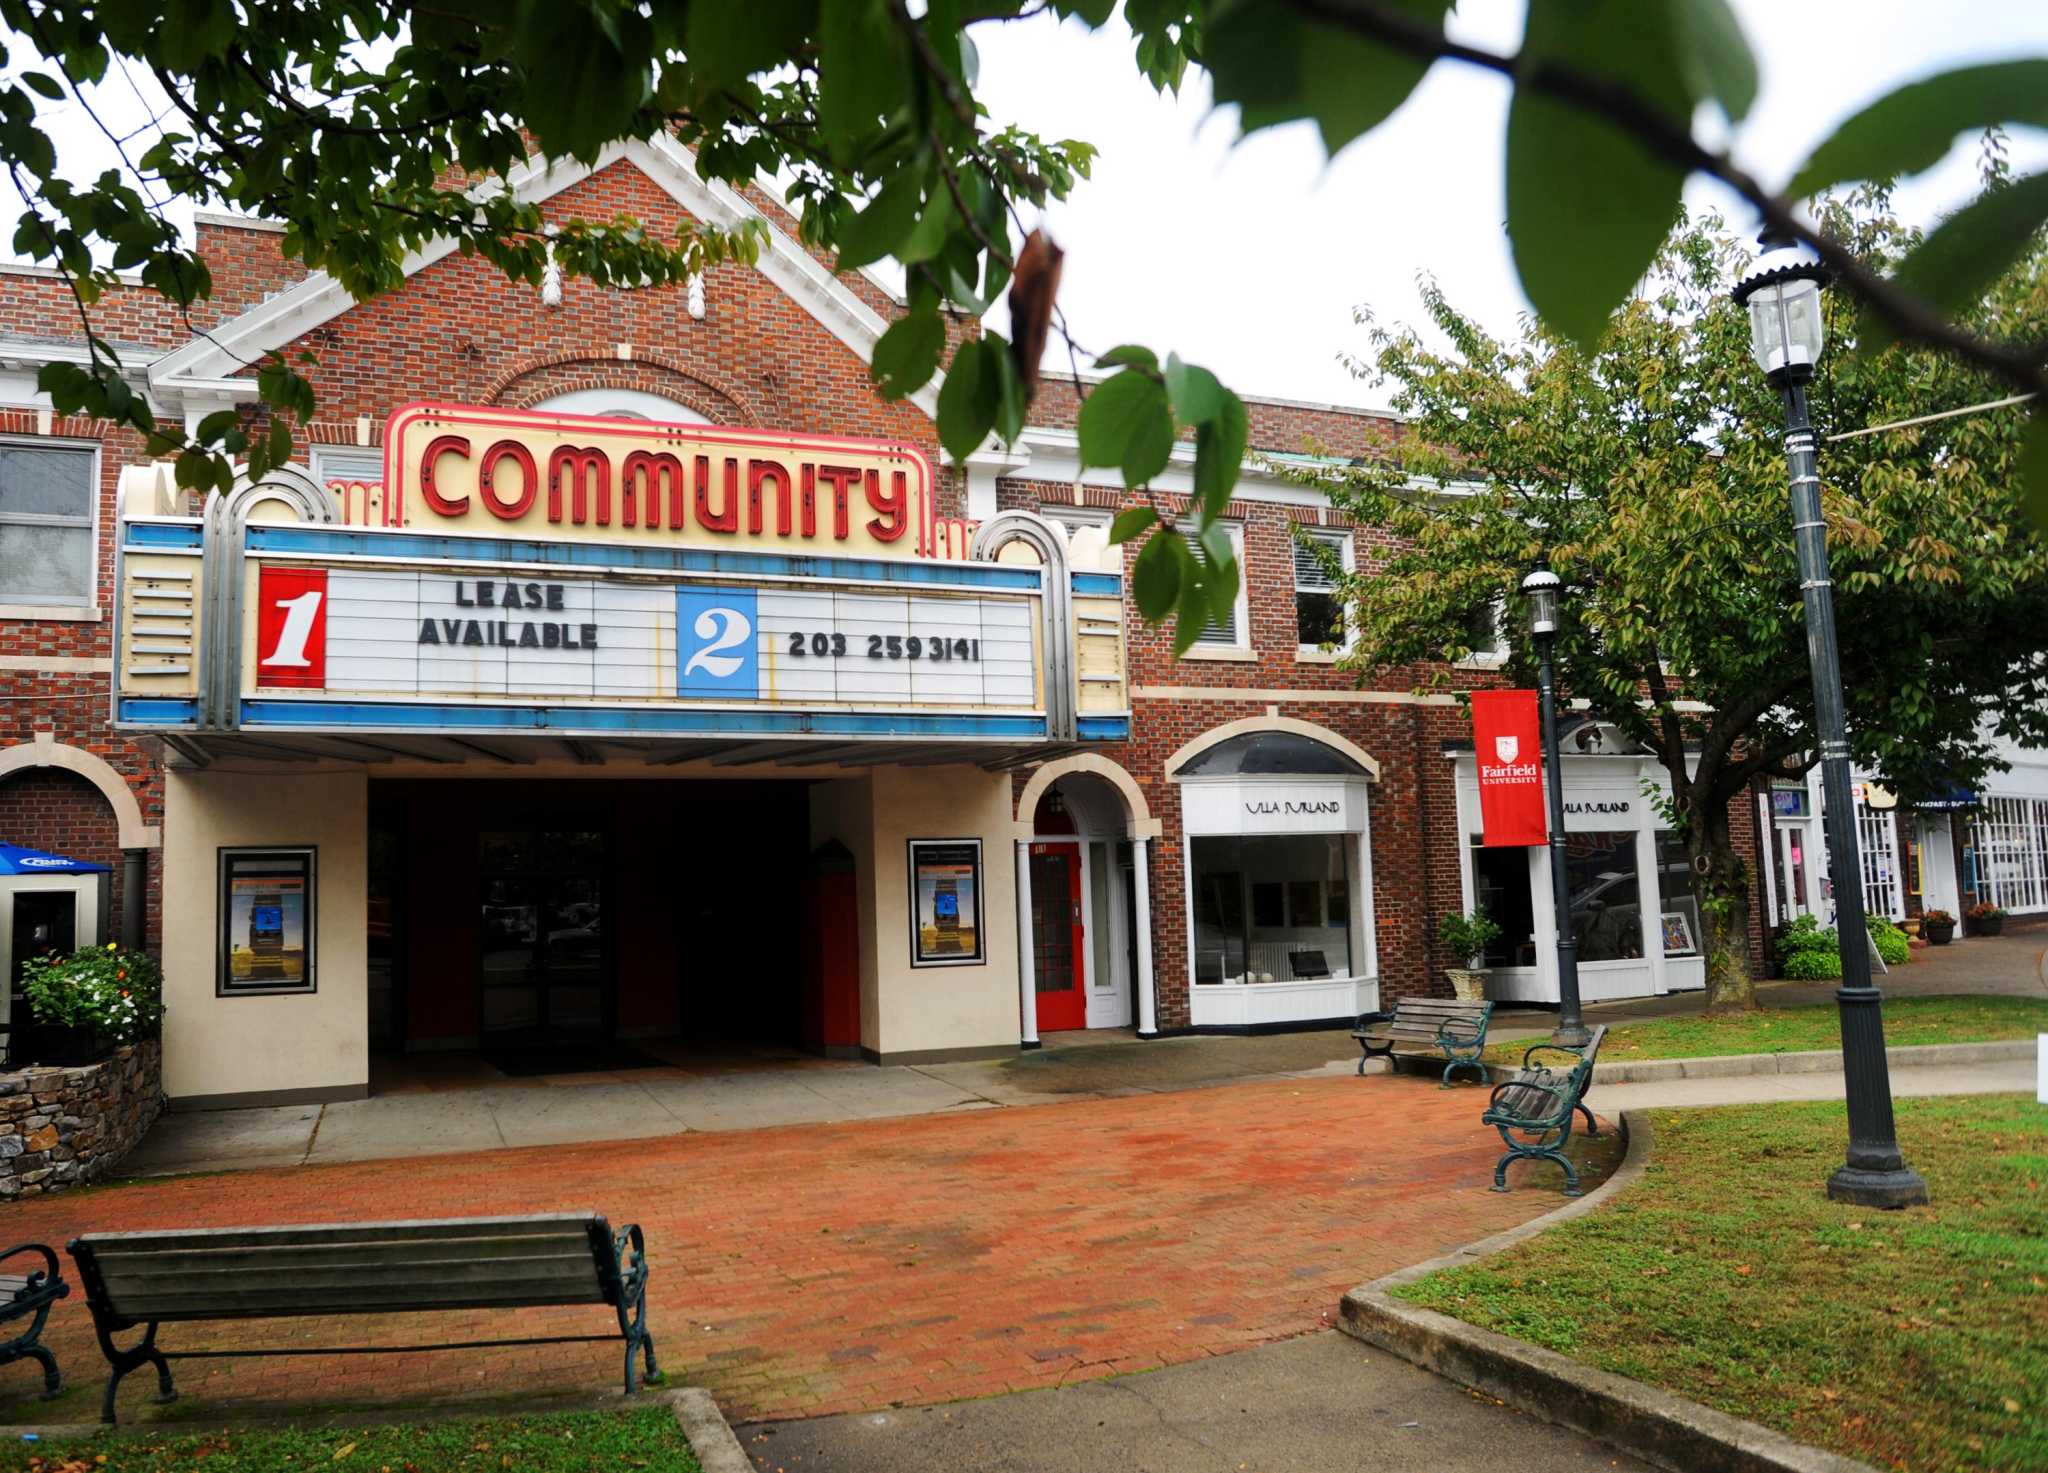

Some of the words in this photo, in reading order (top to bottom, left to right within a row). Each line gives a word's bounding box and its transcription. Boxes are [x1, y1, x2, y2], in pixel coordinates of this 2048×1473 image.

[456, 581, 564, 610] LEASE
[261, 591, 322, 666] 1
[418, 618, 598, 649] AVAILABLE
[684, 607, 751, 678] 2
[789, 632, 846, 657] 203
[1481, 764, 1536, 778] Fairfield
[1482, 777, 1536, 785] UNIVERSITY
